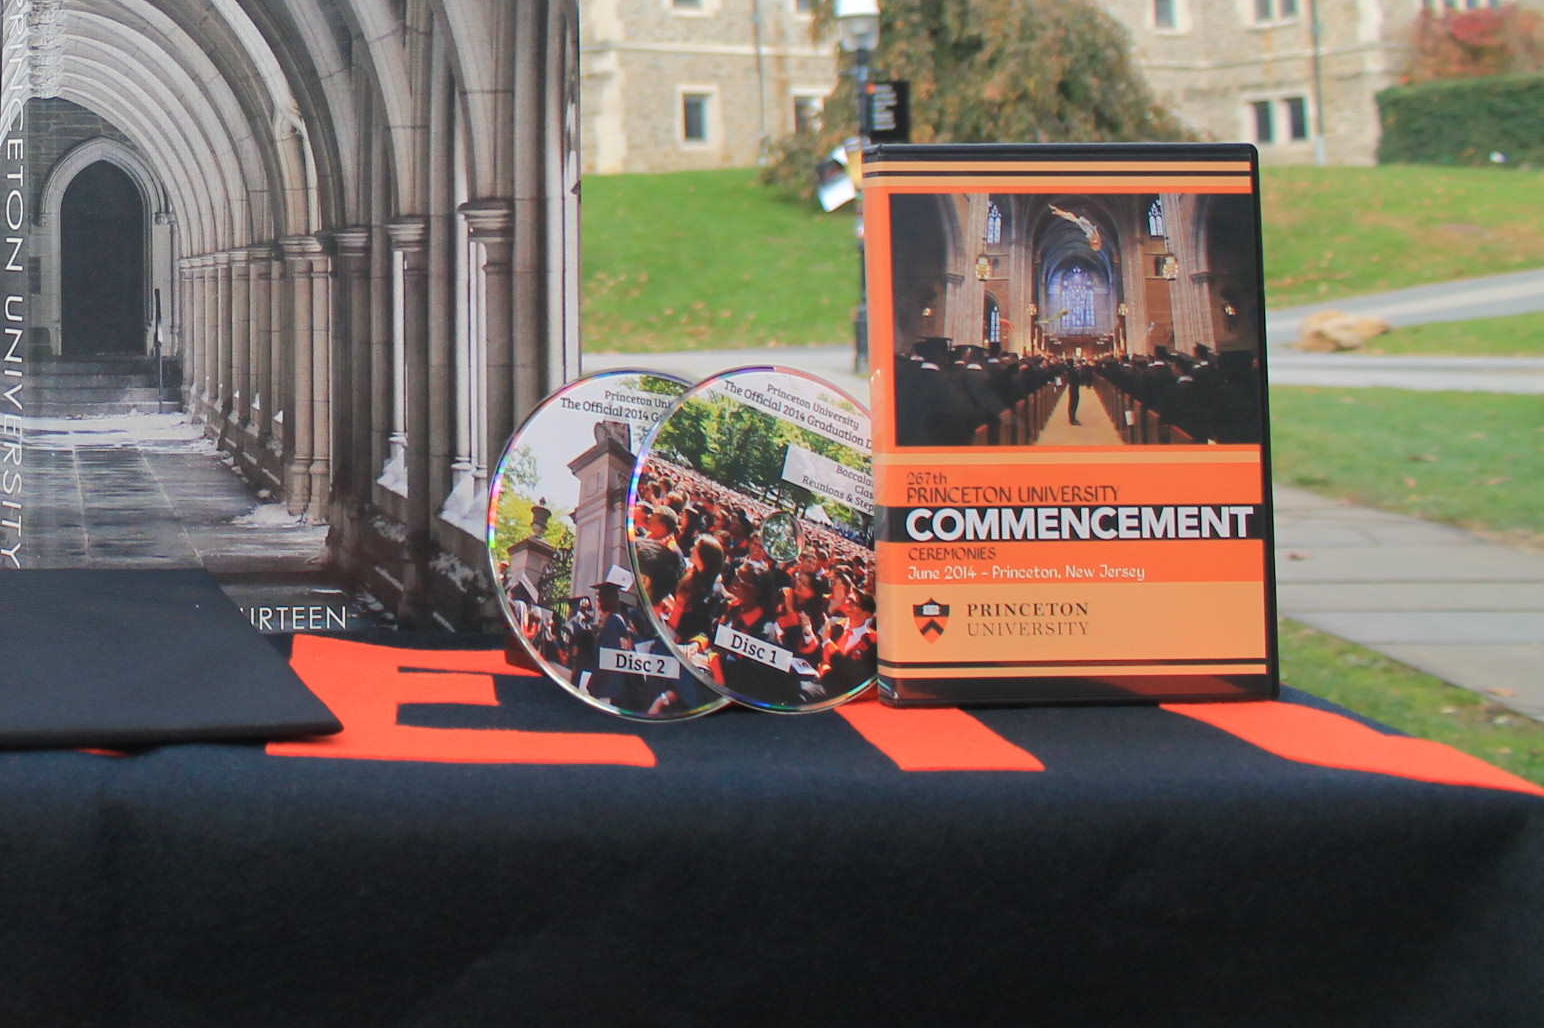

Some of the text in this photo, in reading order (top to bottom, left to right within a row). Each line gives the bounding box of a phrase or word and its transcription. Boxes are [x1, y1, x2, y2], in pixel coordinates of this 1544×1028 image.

[604, 390, 652, 407] Princeton
[767, 383, 860, 432] Princeton University
[560, 397, 581, 410] The
[583, 400, 623, 417] Official
[625, 408, 649, 422] 2014
[724, 380, 744, 396] The
[744, 389, 783, 412] Official
[783, 405, 806, 422] 2014
[807, 415, 864, 447] Graduation
[0, 295, 24, 570] UNIVERSITY
[836, 465, 874, 487] Baccala
[907, 471, 948, 485] 267th
[802, 475, 845, 500] Reunions
[845, 493, 853, 503] &
[854, 485, 874, 500] Clas
[907, 484, 1120, 504] PRINCETON UNIVERSITY
[906, 505, 1254, 542] COMMENCEMENT
[908, 547, 997, 561] CEREMONIES
[908, 566, 940, 581] June
[944, 565, 977, 580] 2014
[1065, 564, 1095, 579] New
[1099, 564, 1146, 582] Jersey
[967, 602, 1090, 618] PRINCETON
[967, 621, 1090, 637] UNIVERSITY
[730, 634, 777, 664] Disc 1
[615, 653, 666, 674] Disc 2
